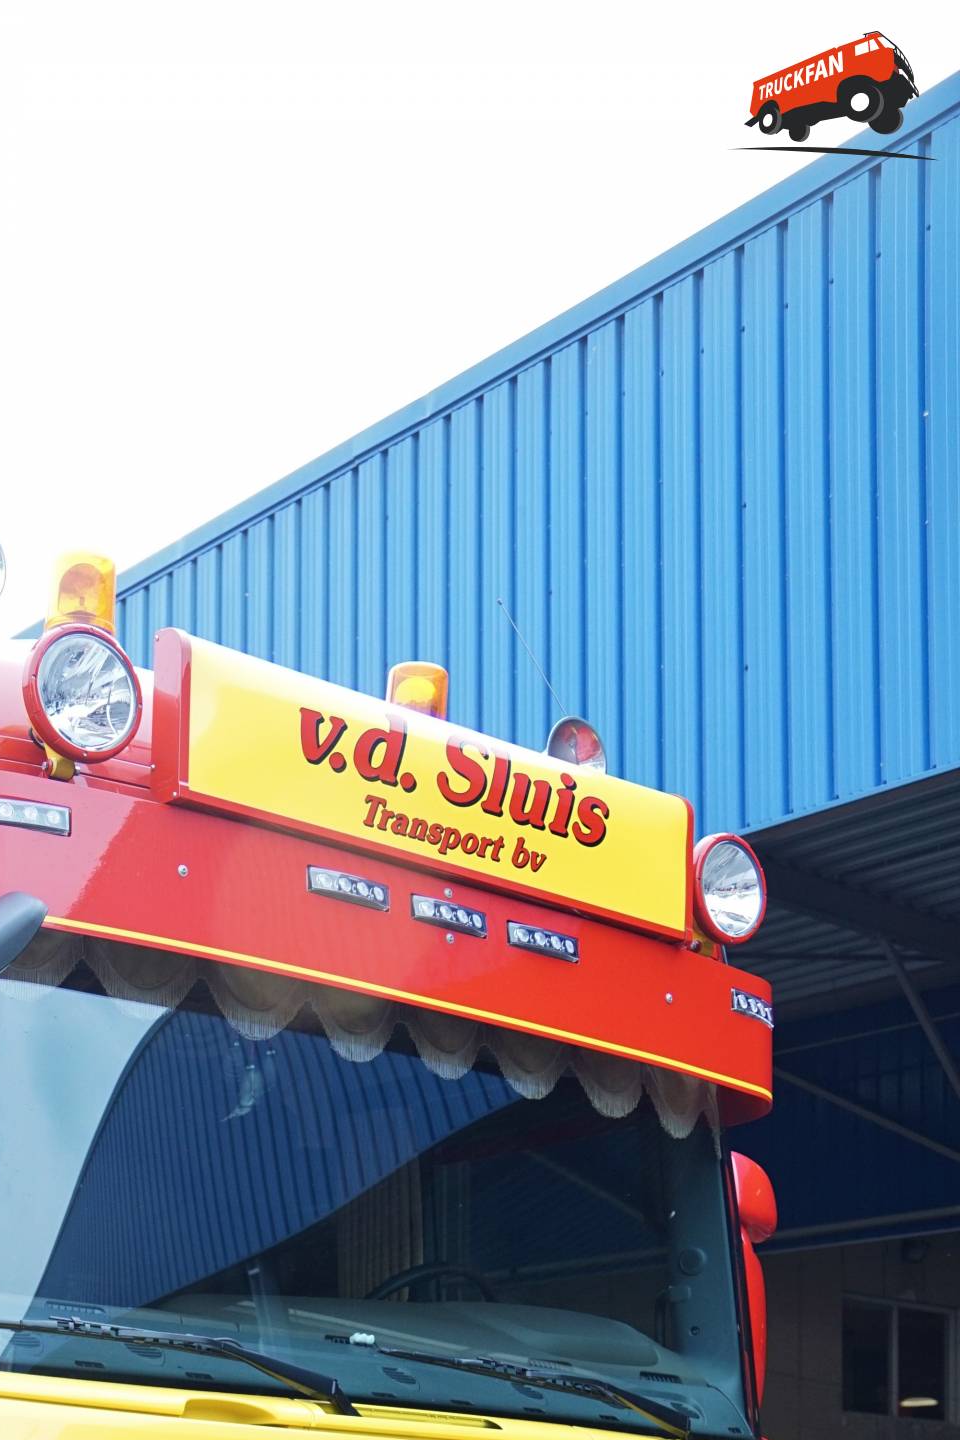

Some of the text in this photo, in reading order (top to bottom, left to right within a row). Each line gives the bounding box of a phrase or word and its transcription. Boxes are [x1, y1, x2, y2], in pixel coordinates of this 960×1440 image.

[299, 706, 610, 847] v.d. Sluis
[362, 794, 547, 872] Transport bv
